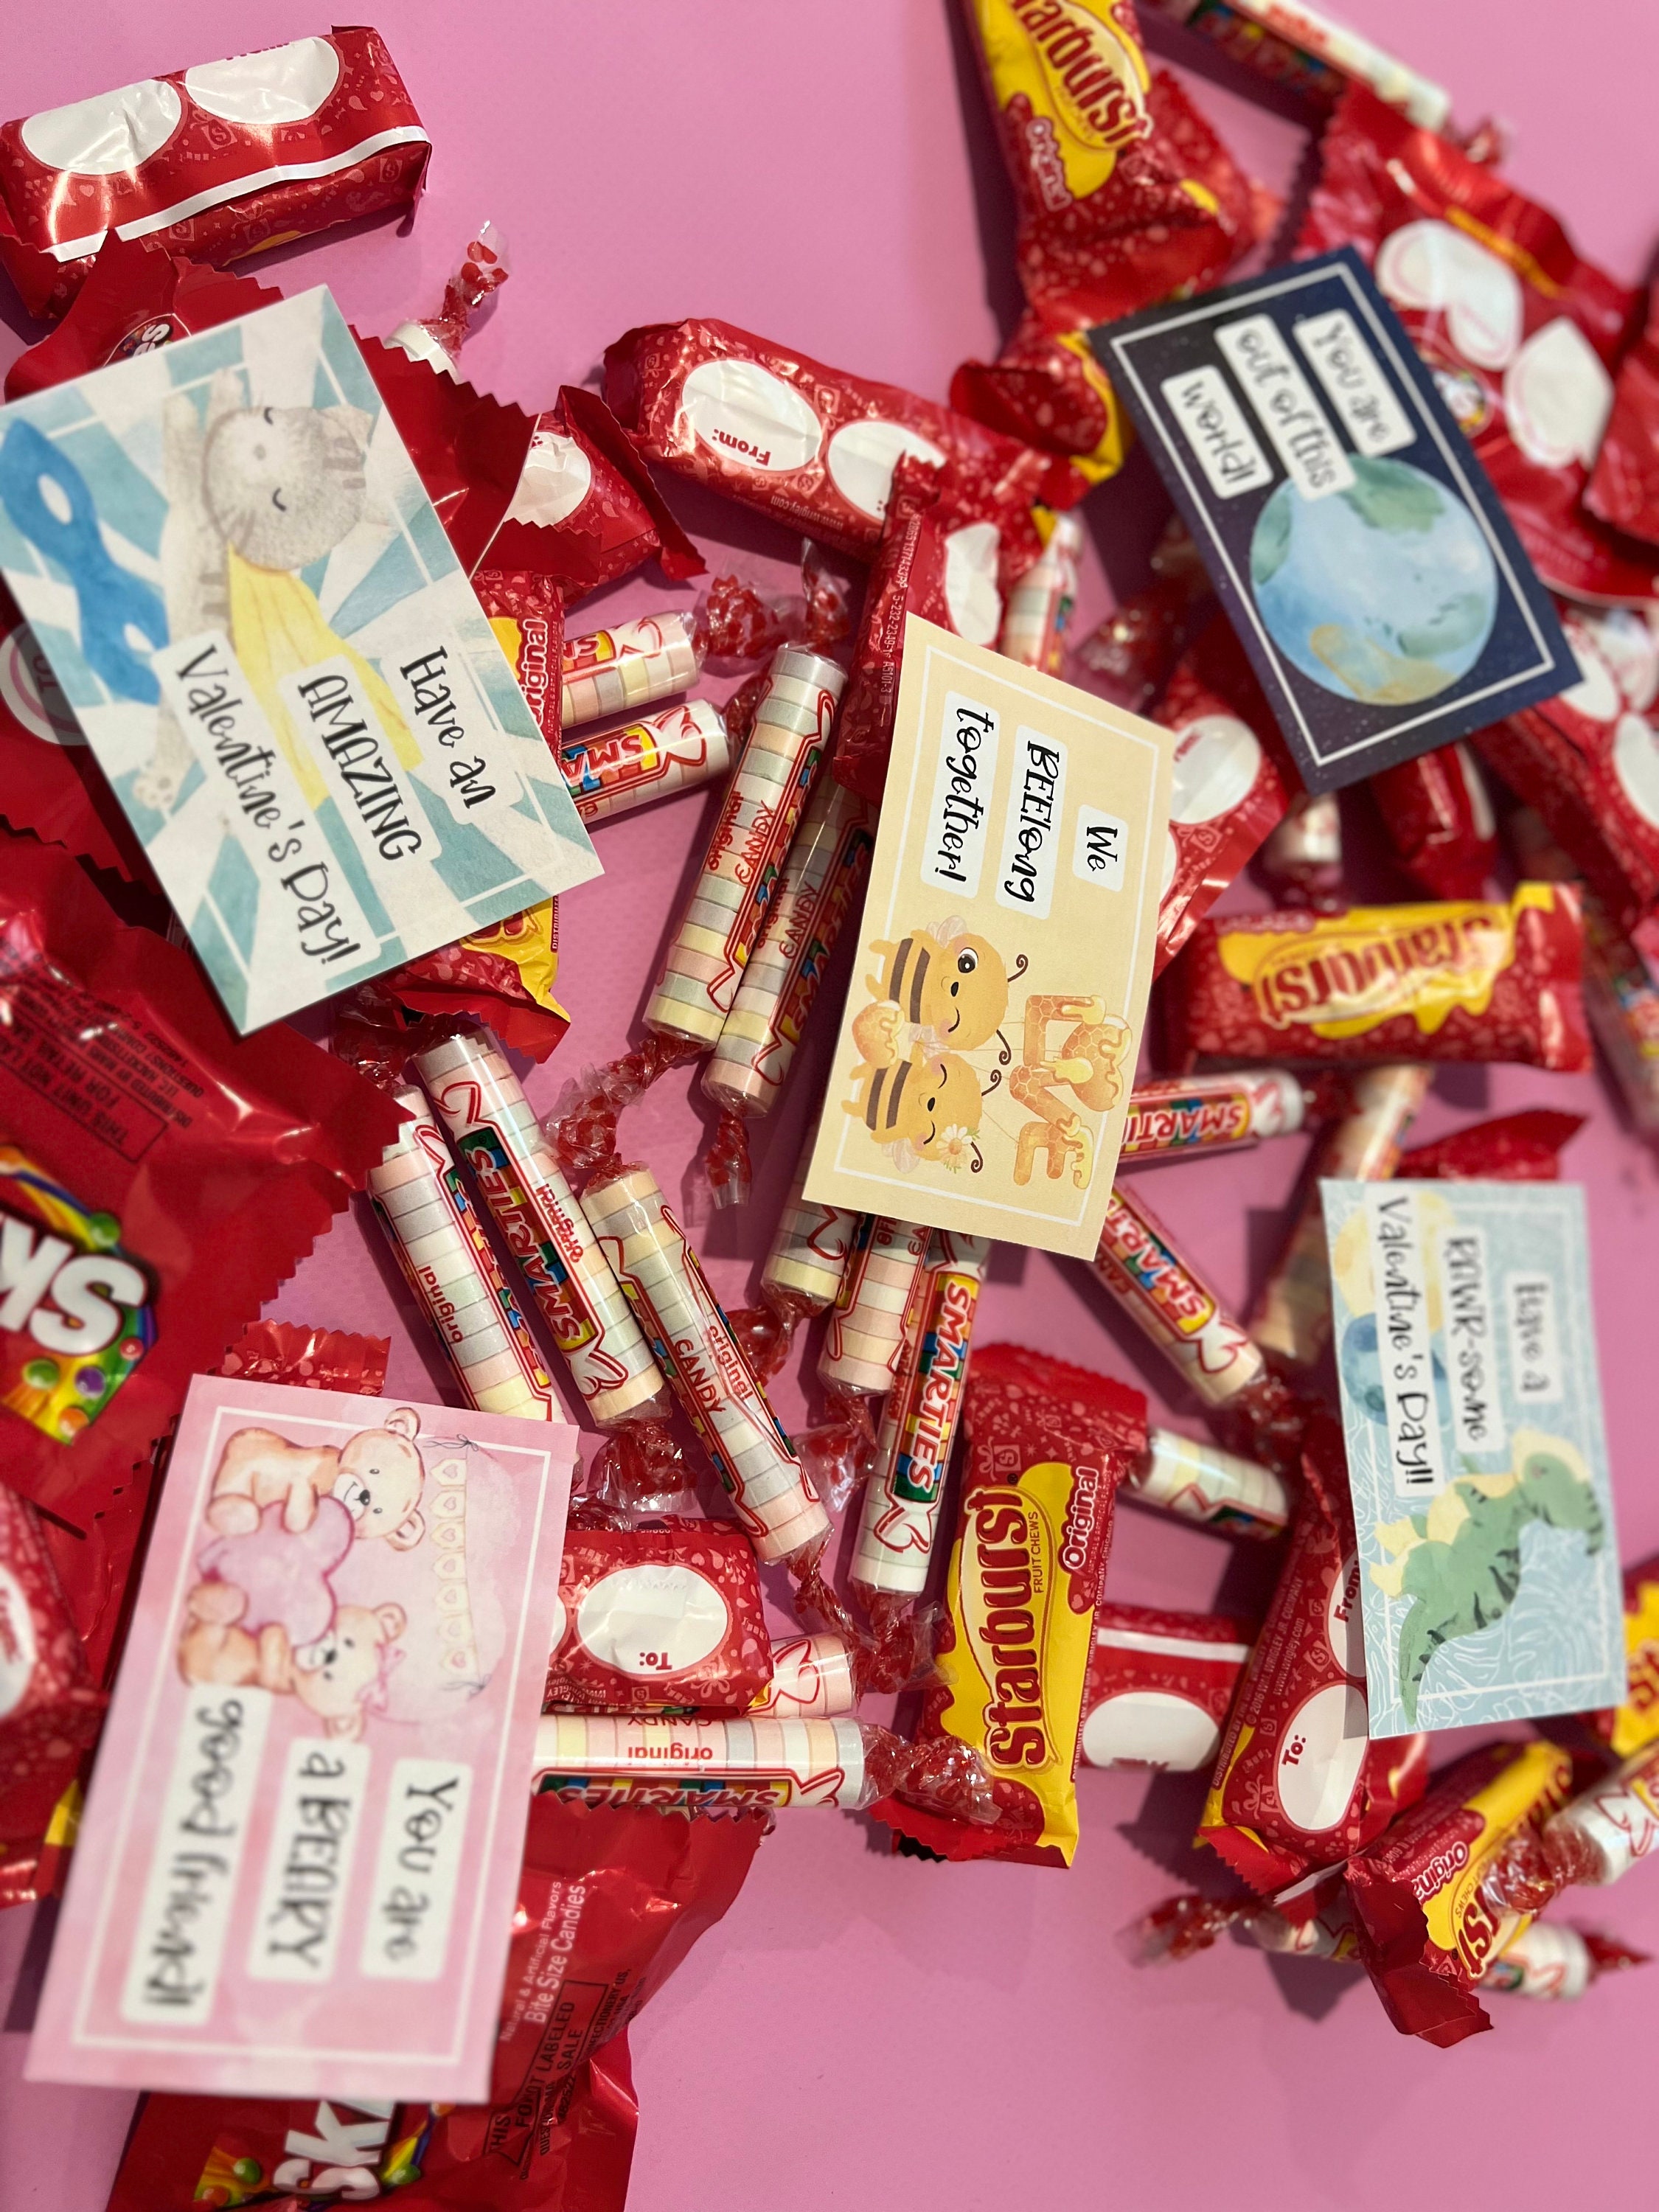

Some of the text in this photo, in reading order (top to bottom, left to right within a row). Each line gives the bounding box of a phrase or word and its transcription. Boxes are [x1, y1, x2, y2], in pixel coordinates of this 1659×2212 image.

[1012, 0, 1148, 143] arburst
[1237, 330, 1338, 489] out of this
[1314, 321, 1390, 442] You are
[713, 428, 771, 466] From:
[1182, 380, 1256, 484] world!
[771, 495, 844, 530] www.wrigley.com
[298, 675, 422, 861] AMAZING
[400, 646, 495, 810] Have an
[177, 644, 361, 964] Valentine's Day!
[707, 790, 744, 872] original
[734, 799, 775, 885] CANDY
[934, 707, 995, 883] together!
[1004, 740, 1060, 903] BEElong
[1085, 825, 1119, 872] We
[779, 881, 821, 959] CANDY
[465, 1147, 582, 1340] SMARTIES
[1377, 1195, 1425, 1380] Valentine's
[418, 1265, 464, 1343] original
[674, 1338, 727, 1412] CANDY
[908, 1281, 973, 1493] SMARTIES
[1520, 1369, 1550, 1394] a
[1029, 1512, 1045, 1594] FRUIT CHEWS
[1062, 1465, 1099, 1570] Original
[967, 1489, 1046, 1766] Starburst
[1333, 1559, 1361, 1622] From:
[639, 1652, 672, 1671] To:
[1252, 1691, 1266, 1714] 2016
[1264, 1637, 1284, 1673] WRIGLEY
[1273, 1616, 1305, 1695] www.wrigley.com
[180, 1699, 244, 1837] good
[298, 1751, 347, 1778] a
[1281, 1734, 1307, 1767] To:
[382, 1777, 459, 1962] You are
[522, 1933, 550, 1986] Artificial
[540, 1881, 562, 1930] Flavors
[524, 1885, 586, 2025] Bite Size Candies
[535, 2001, 575, 2074] LABELED
[557, 2028, 582, 2071] SALE
